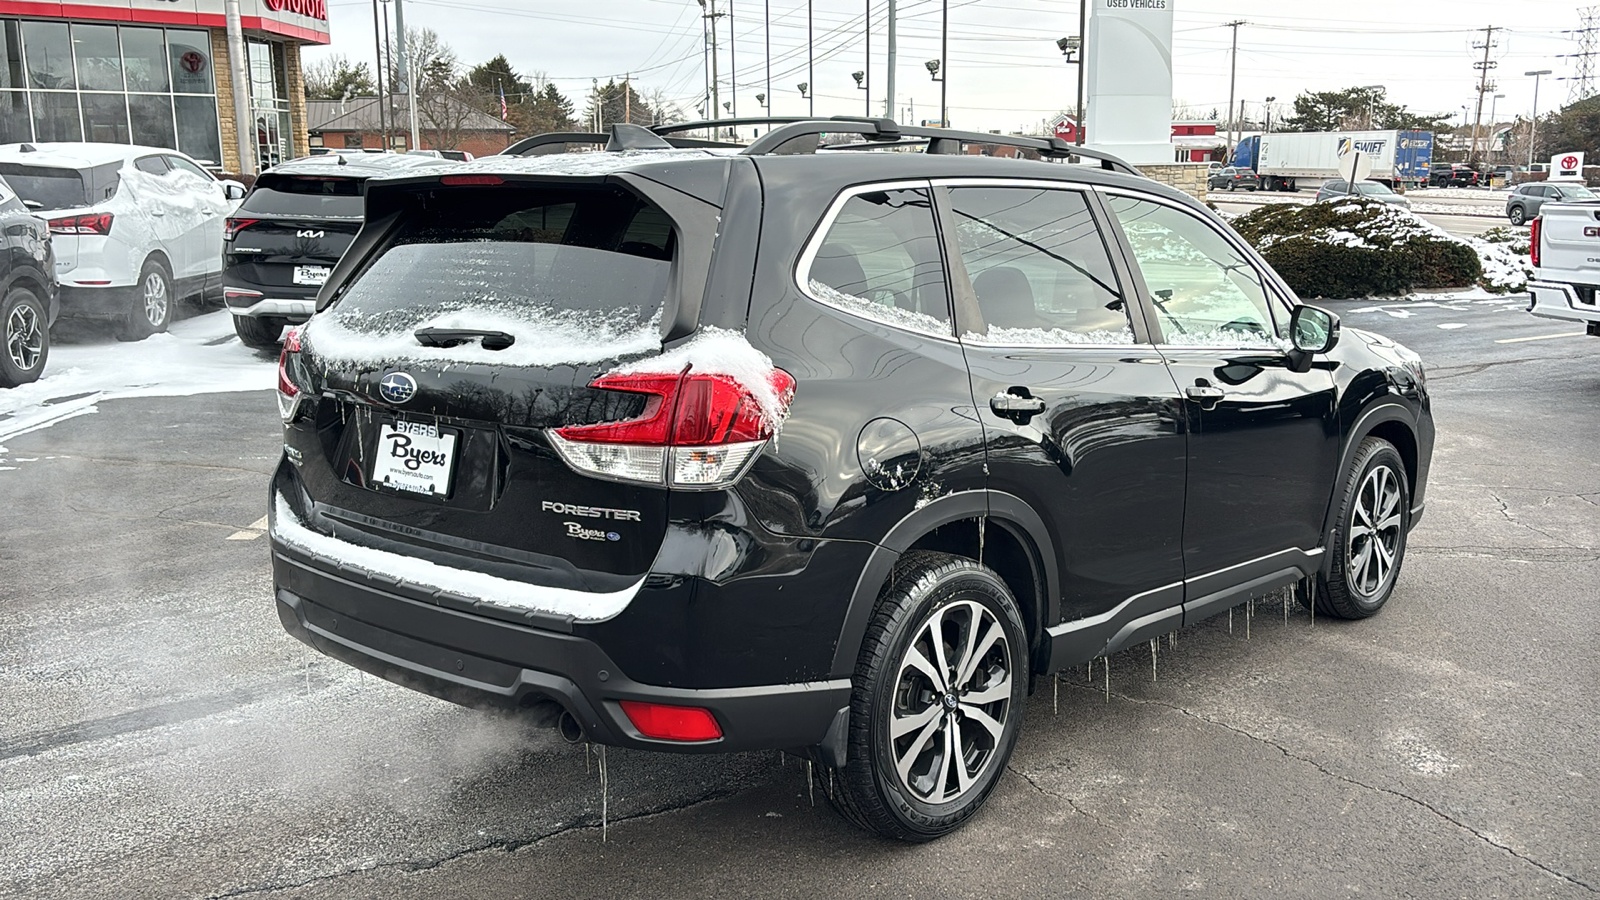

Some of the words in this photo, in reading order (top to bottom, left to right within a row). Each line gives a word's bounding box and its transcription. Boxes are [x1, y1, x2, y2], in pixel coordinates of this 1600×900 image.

[1107, 0, 1128, 8] USED
[1131, 0, 1166, 9] VEHICLES
[1354, 141, 1385, 153] SWIFT
[397, 420, 438, 438] BYERS
[386, 433, 446, 470] Byers
[389, 467, 434, 481] www.byersauto.com
[541, 500, 642, 522] FORESTER
[563, 521, 606, 540] Byers
